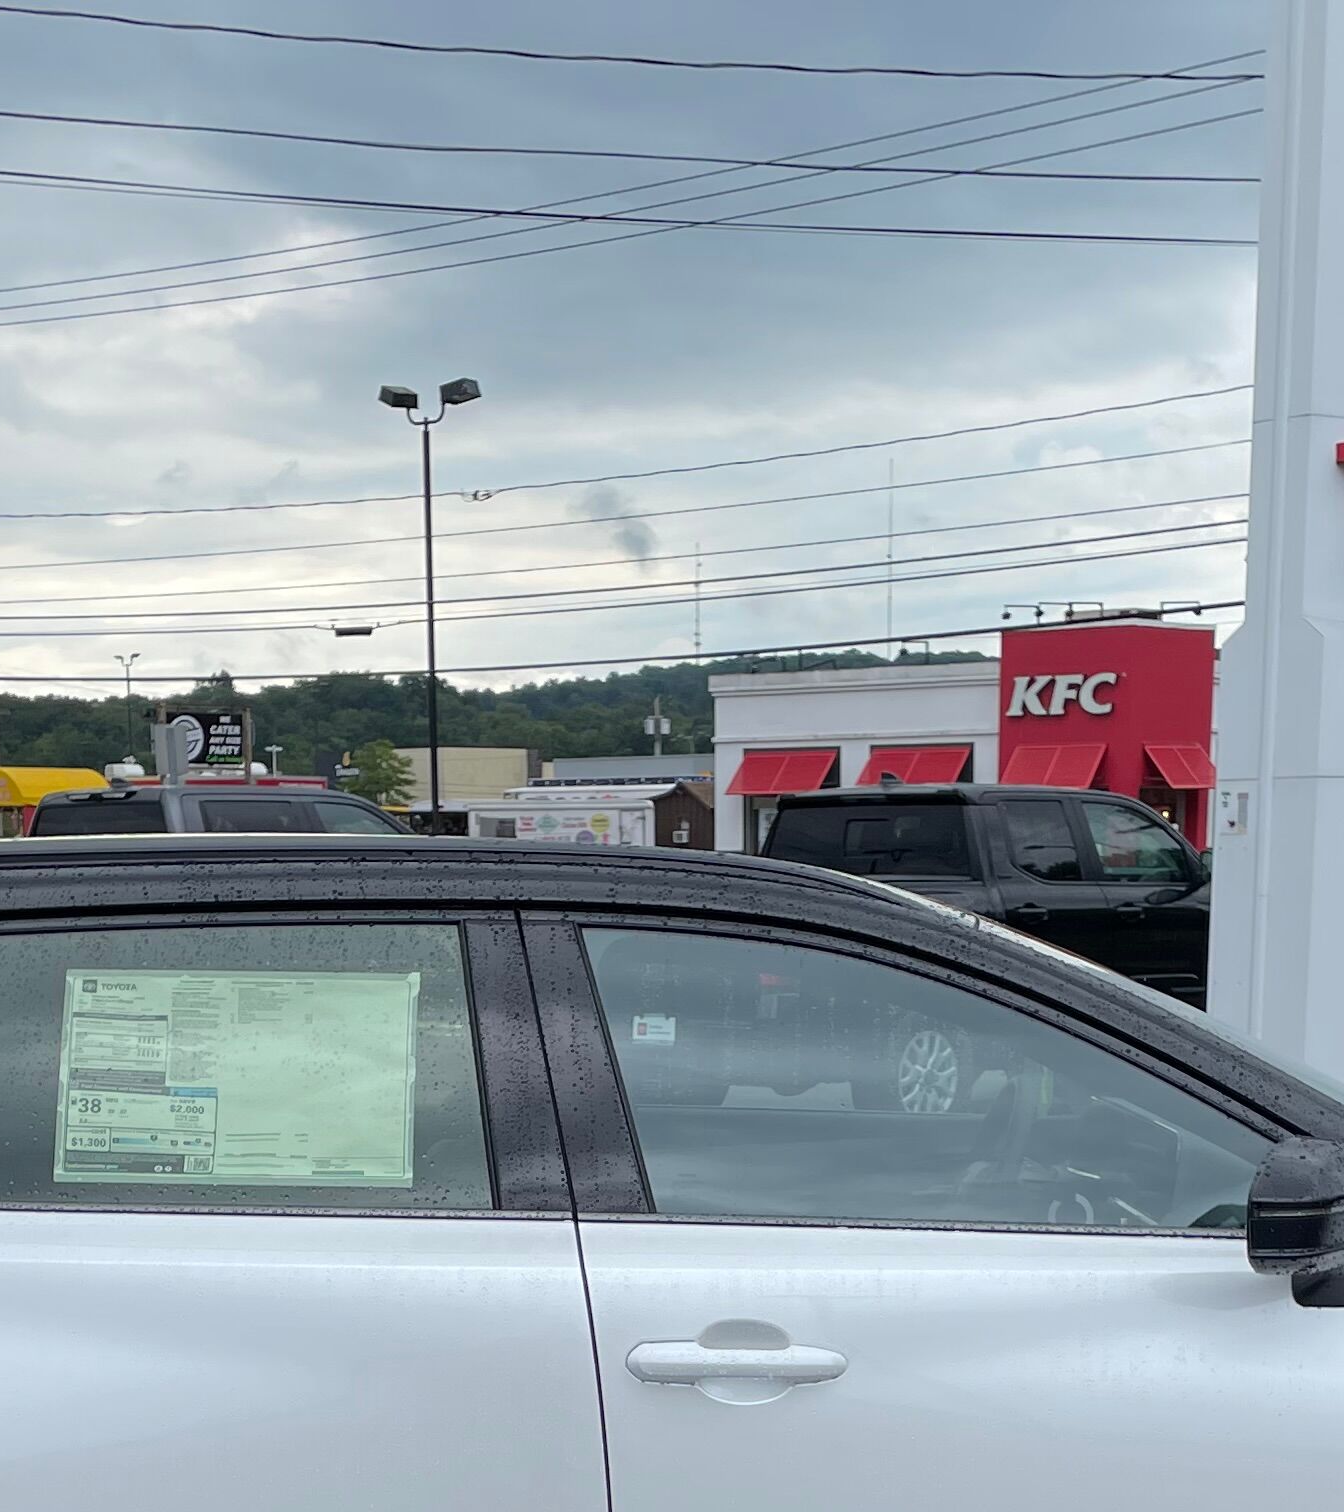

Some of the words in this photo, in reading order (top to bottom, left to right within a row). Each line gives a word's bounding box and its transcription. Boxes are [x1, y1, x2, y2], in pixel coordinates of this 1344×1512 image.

[1006, 671, 1118, 717] KFC
[209, 724, 240, 735] CATER
[209, 745, 240, 755] PARTY
[100, 982, 138, 991] TOYOTA
[78, 1097, 102, 1114] 38
[169, 1104, 205, 1114] $2,000
[71, 1137, 106, 1148] $1,300
